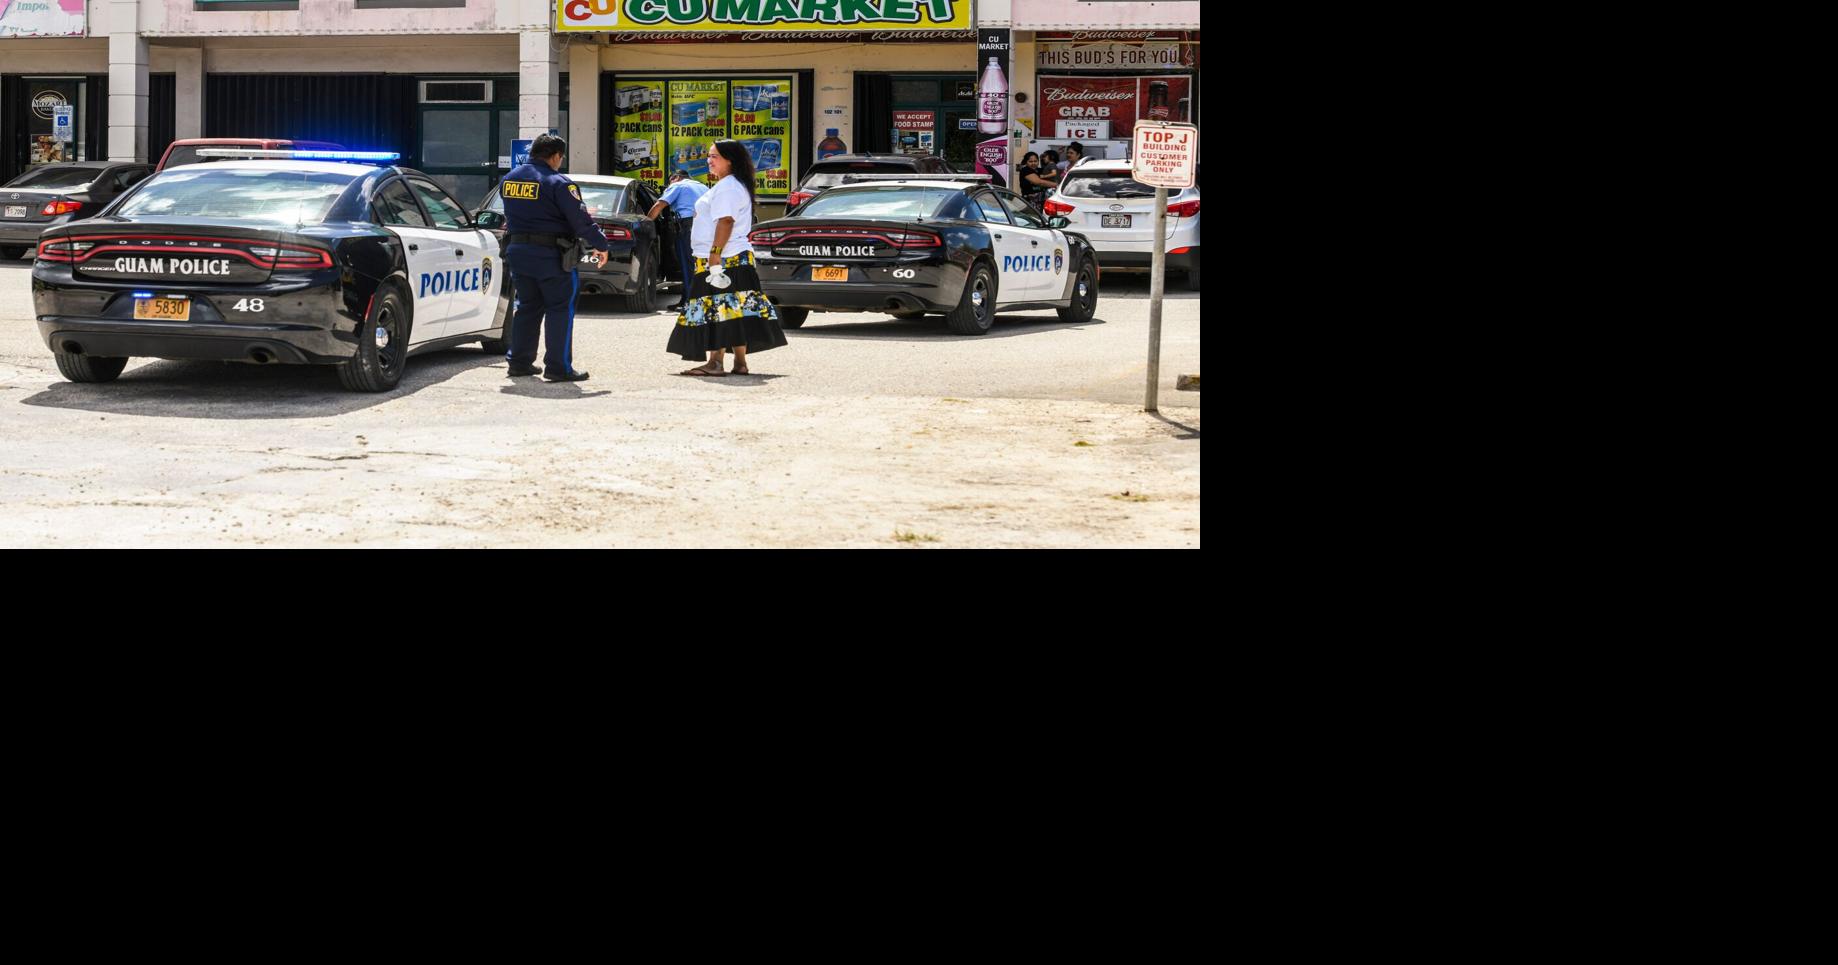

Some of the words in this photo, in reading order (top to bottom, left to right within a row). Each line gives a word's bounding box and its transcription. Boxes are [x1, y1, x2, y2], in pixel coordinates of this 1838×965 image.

[1039, 51, 1070, 65] THIS
[1074, 50, 1115, 64] BUD'S
[1120, 50, 1146, 64] FOR
[1151, 49, 1177, 63] YOU
[1043, 88, 1135, 102] Budweiser
[1059, 106, 1110, 117] GRAB
[620, 122, 641, 133] PACK
[642, 123, 663, 133] cans
[671, 127, 680, 137] 12
[681, 127, 702, 137] PACK
[704, 127, 724, 137] cans
[734, 125, 740, 136] 6
[741, 125, 763, 136] PACK
[764, 126, 785, 136] cans
[1067, 129, 1097, 138] ICE
[1143, 131, 1173, 143] TOP
[1179, 134, 1188, 143] J
[1143, 143, 1187, 151] BUILDING
[1140, 152, 1188, 160] CUSTOMER
[767, 180, 787, 188] cans
[505, 183, 534, 197] POLICE
[118, 240, 222, 248] DODGE
[799, 245, 831, 256] GUAM
[835, 245, 875, 256] POLICE
[580, 254, 600, 264] 46
[1003, 255, 1051, 273] POLICE
[114, 257, 164, 274] GUAM
[169, 258, 231, 275] POLICE
[825, 270, 844, 278] 6691
[892, 268, 915, 279] 60
[419, 267, 480, 299] POLICE
[155, 300, 185, 315] 5830
[231, 298, 265, 312] 48
